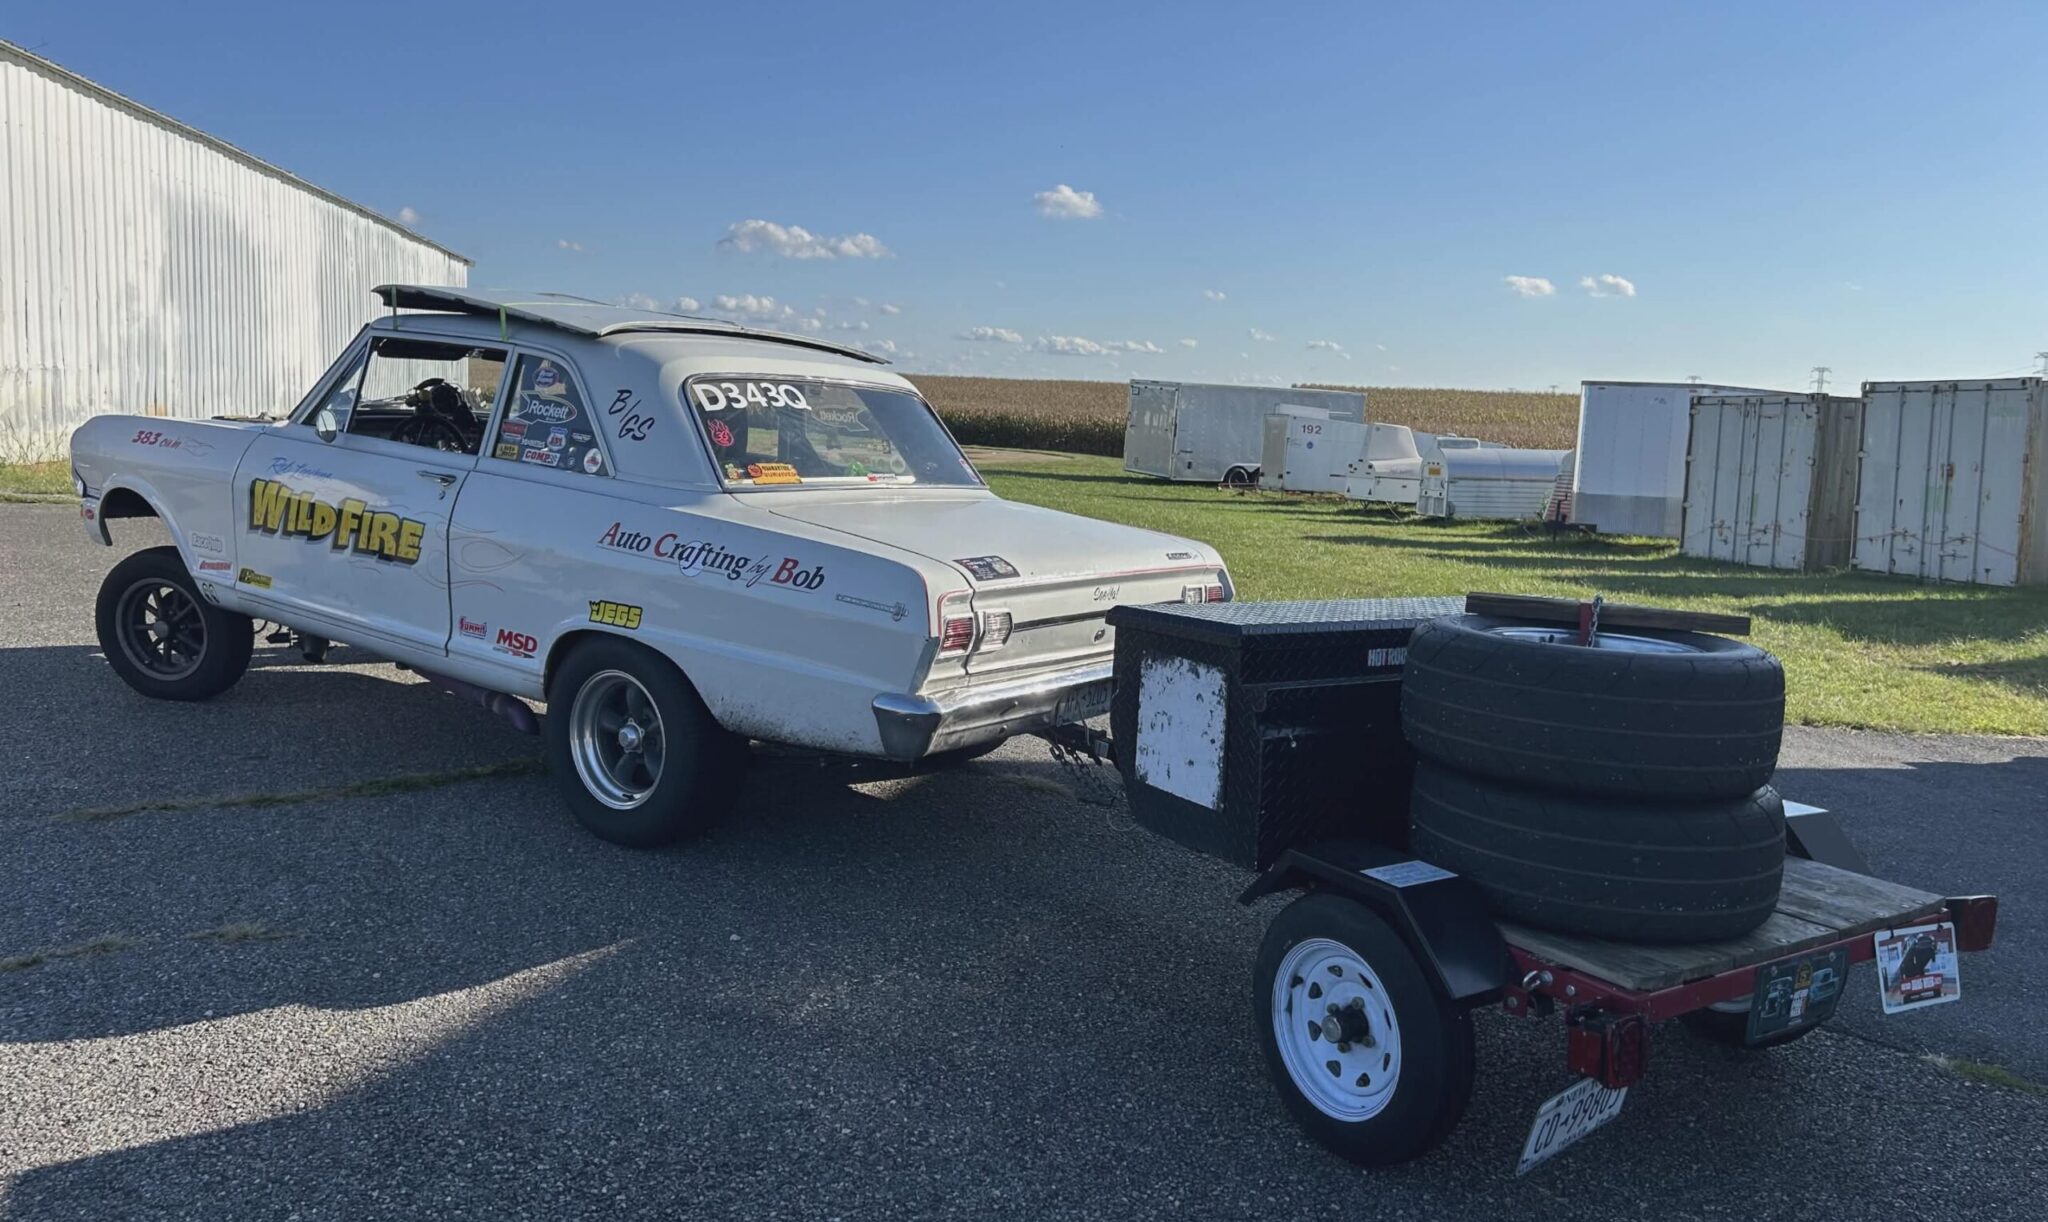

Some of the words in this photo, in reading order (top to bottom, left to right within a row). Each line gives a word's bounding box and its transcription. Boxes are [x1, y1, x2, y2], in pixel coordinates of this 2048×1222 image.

[692, 382, 812, 411] D343Q
[528, 400, 569, 419] Rockett
[131, 430, 163, 445] 383
[1302, 424, 1322, 435] 192
[525, 450, 551, 464] COMP
[598, 522, 652, 552] Auto
[654, 533, 751, 580] Crafting
[746, 555, 772, 588] by
[770, 558, 825, 590] Bob
[590, 600, 643, 630] JEGS
[495, 628, 538, 654] MSD
[1367, 648, 1388, 667] HOT
